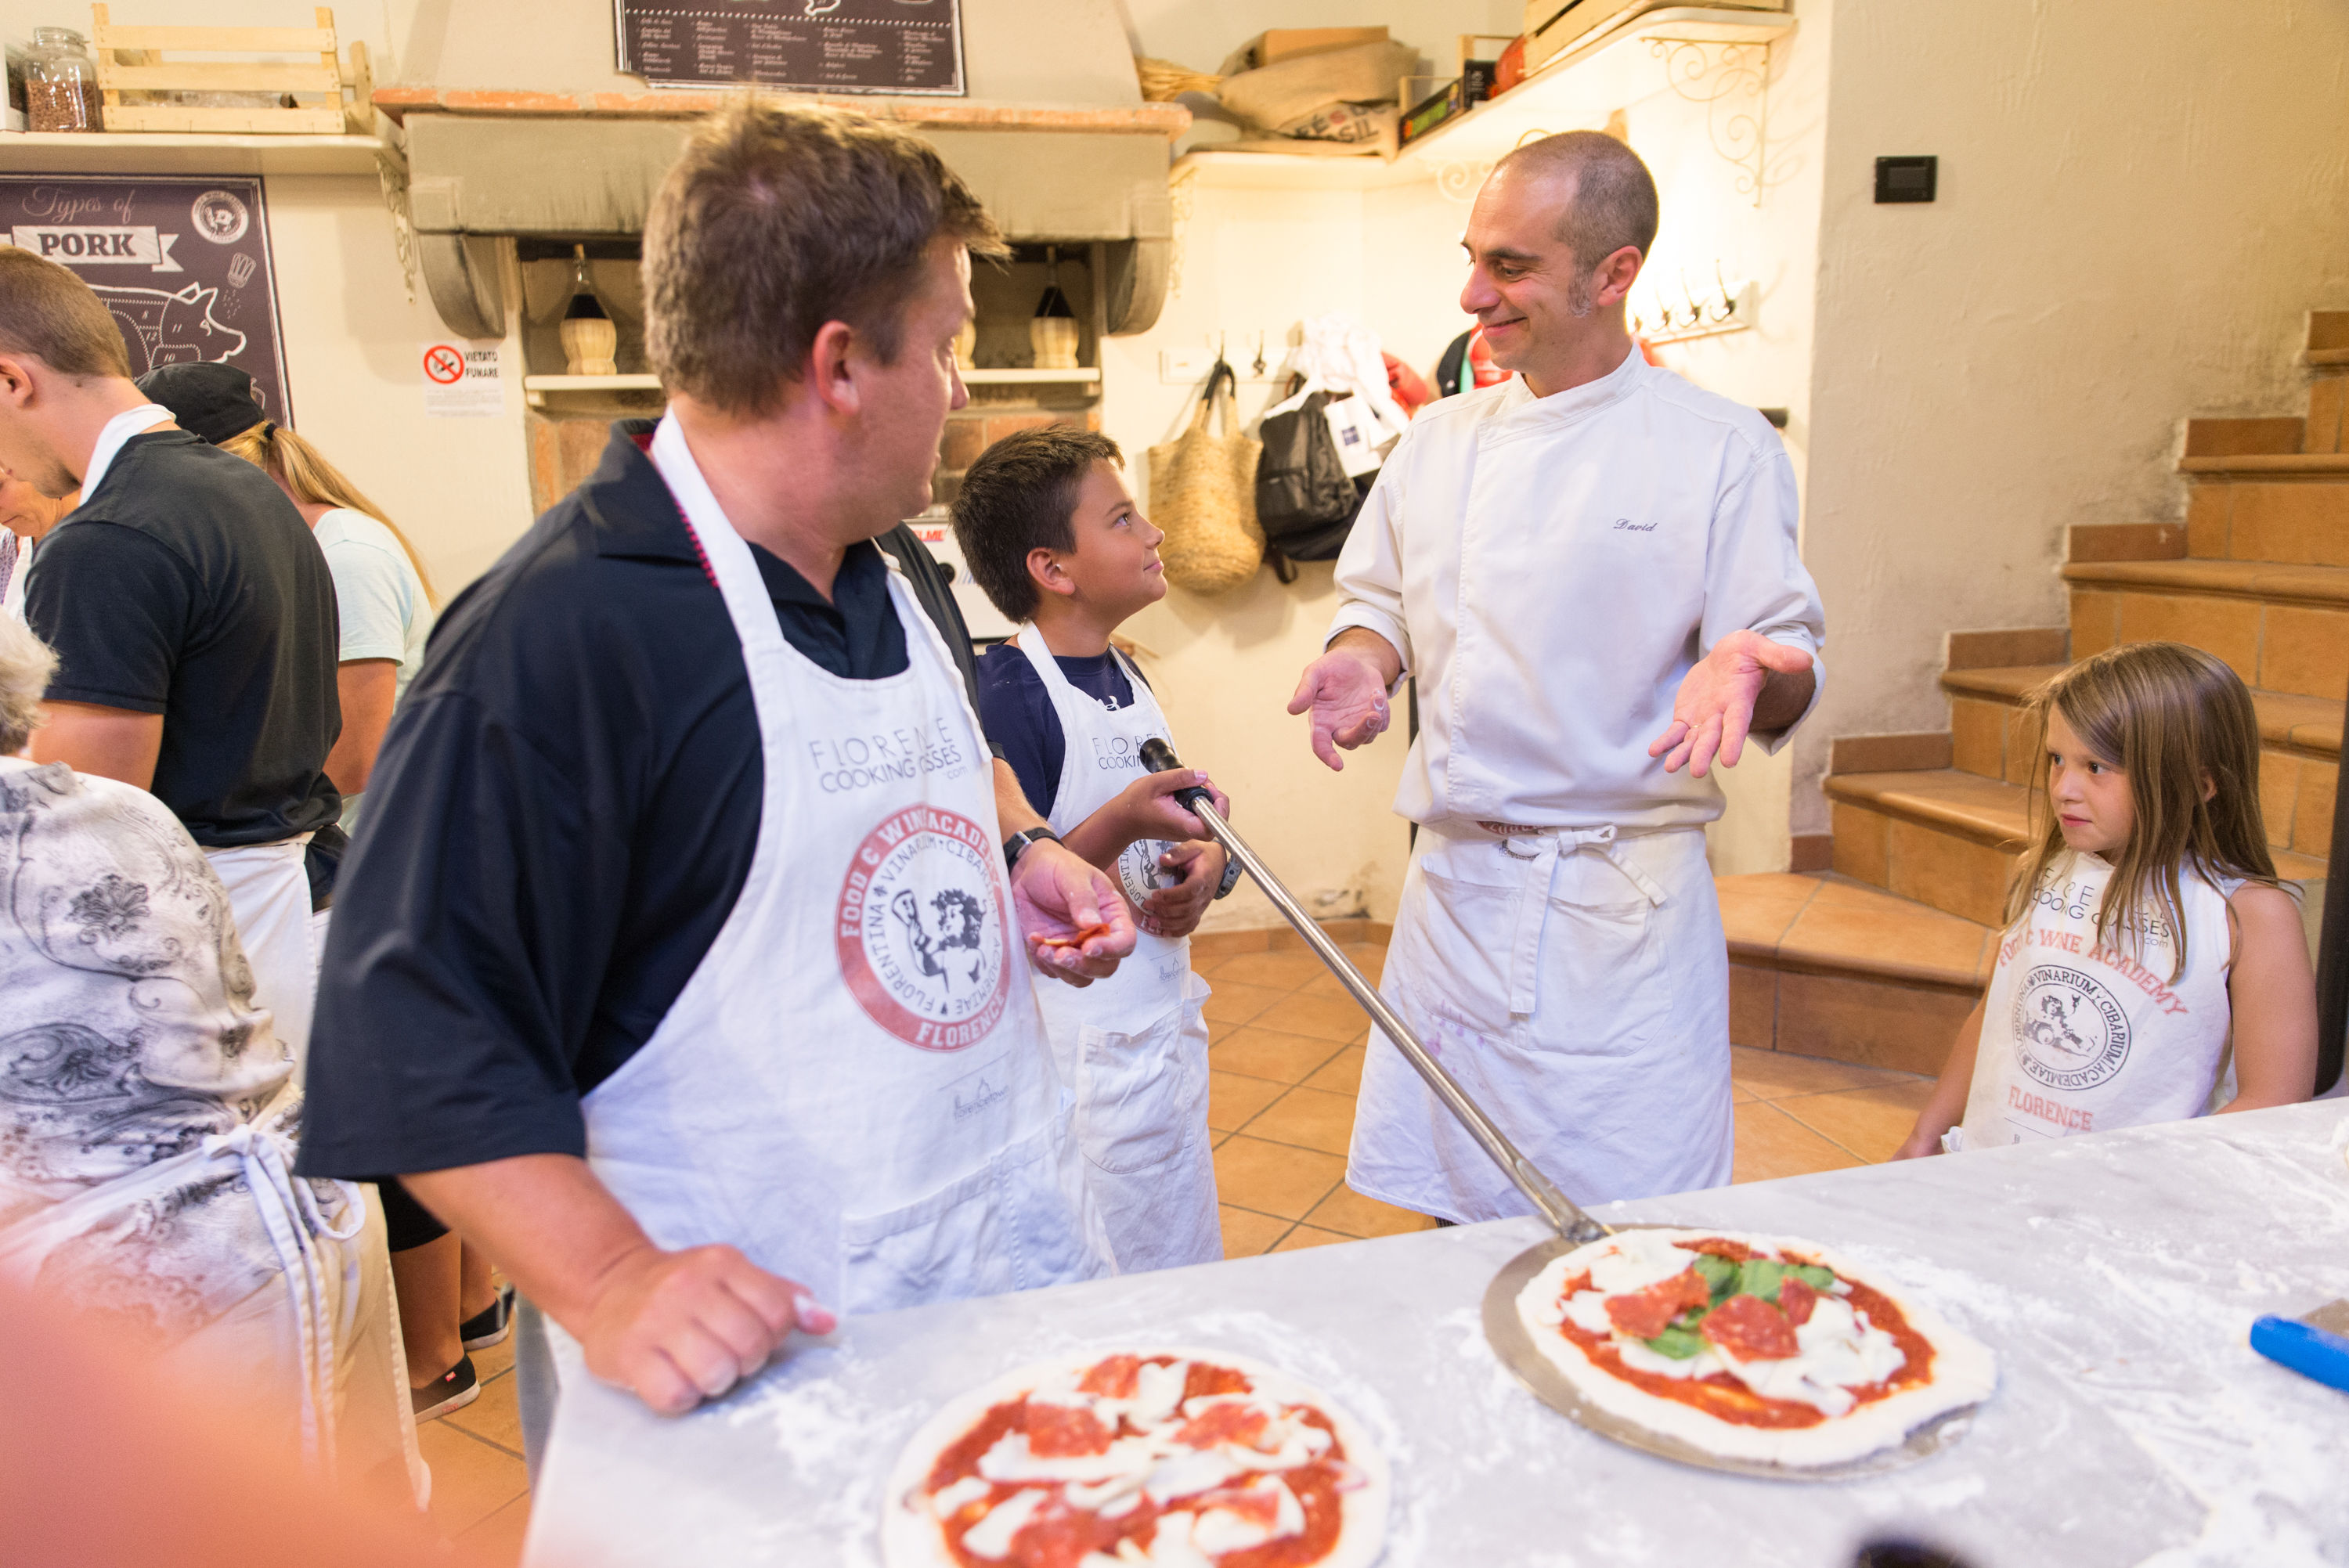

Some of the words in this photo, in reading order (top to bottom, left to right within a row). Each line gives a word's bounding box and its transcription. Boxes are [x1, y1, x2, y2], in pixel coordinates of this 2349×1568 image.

[22, 186, 103, 223] Types
[114, 189, 135, 224] of
[38, 233, 136, 256] PORK
[164, 353, 175, 363] 10
[465, 351, 499, 362] VIETATO
[466, 368, 500, 377] FUMARE
[1613, 518, 1658, 532] David
[820, 758, 916, 794] COOKING
[841, 871, 868, 938] FOOD
[868, 903, 935, 1012] FLORENTINA
[2087, 943, 2189, 1015] ACADEMY
[2033, 969, 2098, 994] VINARIUM
[2100, 1000, 2126, 1065] CIBARIUM
[2008, 1086, 2093, 1132] FLORENCE
